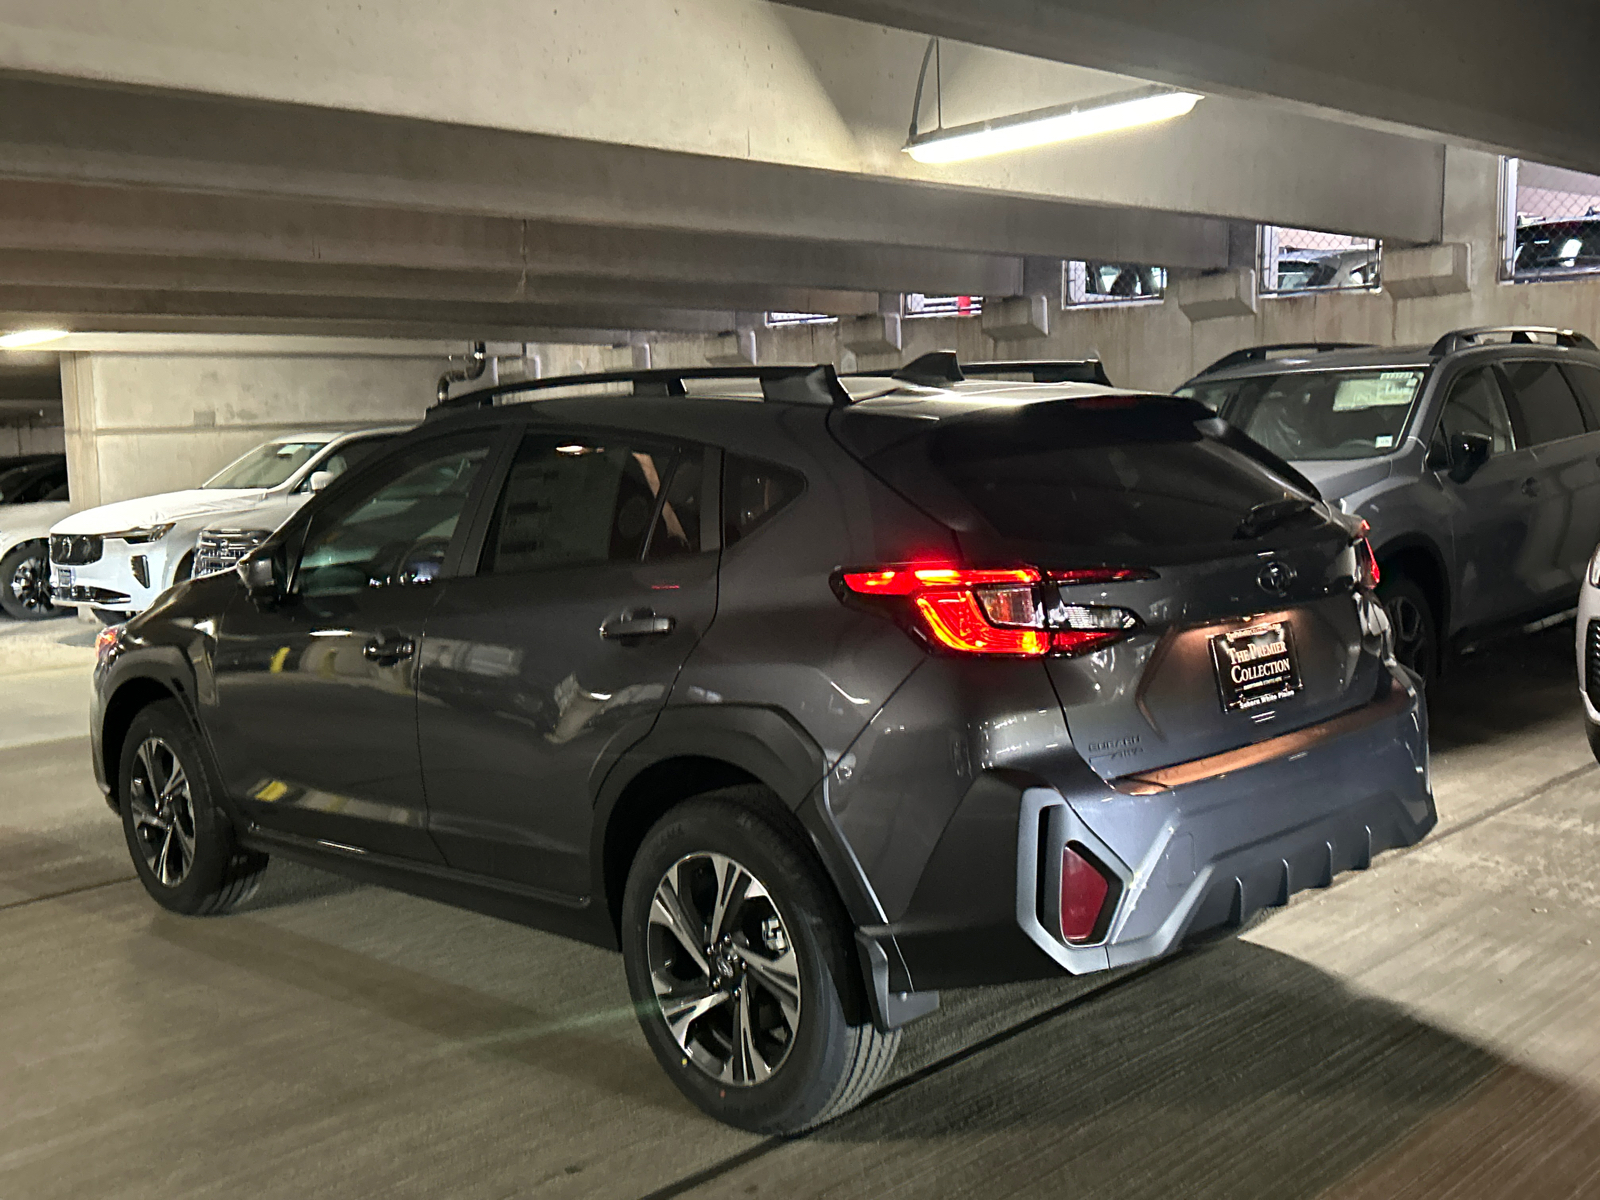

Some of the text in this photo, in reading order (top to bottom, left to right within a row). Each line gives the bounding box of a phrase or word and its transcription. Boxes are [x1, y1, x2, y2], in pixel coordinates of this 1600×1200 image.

[1227, 641, 1287, 664] THE PREMIER
[1231, 659, 1290, 683] COLLECTION
